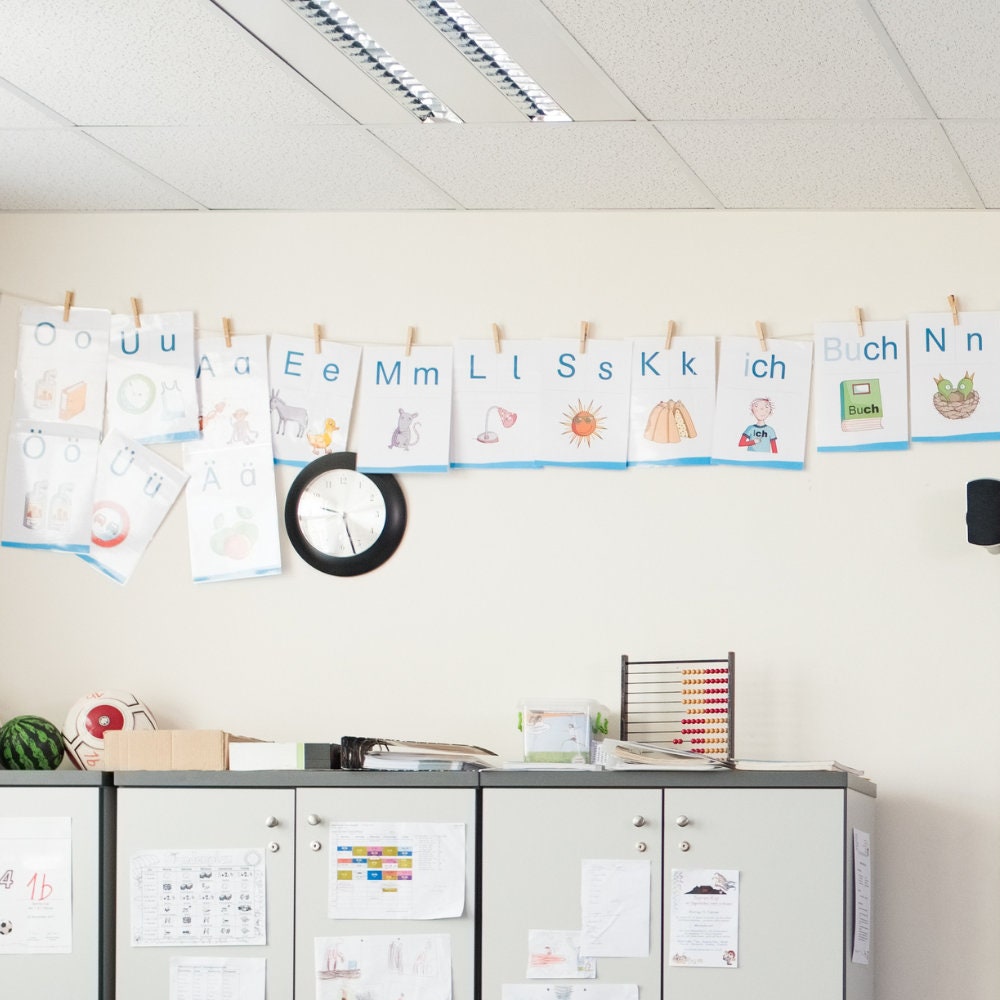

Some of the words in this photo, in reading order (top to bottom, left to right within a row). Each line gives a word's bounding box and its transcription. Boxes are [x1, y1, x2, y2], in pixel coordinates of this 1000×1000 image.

[34, 321, 57, 347] O
[74, 330, 93, 350] o
[120, 330, 140, 356] U
[160, 333, 176, 353] u
[823, 335, 899, 363] Buch
[924, 327, 946, 353] N
[966, 332, 983, 352] n
[195, 354, 217, 380] A
[233, 355, 251, 376] a
[284, 350, 305, 377] E
[322, 362, 340, 382] e
[375, 360, 402, 386] M
[413, 367, 439, 387] m
[469, 354, 487, 380] L
[513, 354, 522, 381] l
[557, 352, 576, 379] S
[598, 361, 614, 381] s
[641, 351, 661, 377] K
[681, 350, 698, 376] k
[743, 351, 787, 381] ich
[847, 403, 881, 416] Buch
[22, 428, 47, 460] Ö
[201, 459, 222, 492] Ä
[239, 461, 257, 488] ä
[26, 871, 54, 901] 1b
